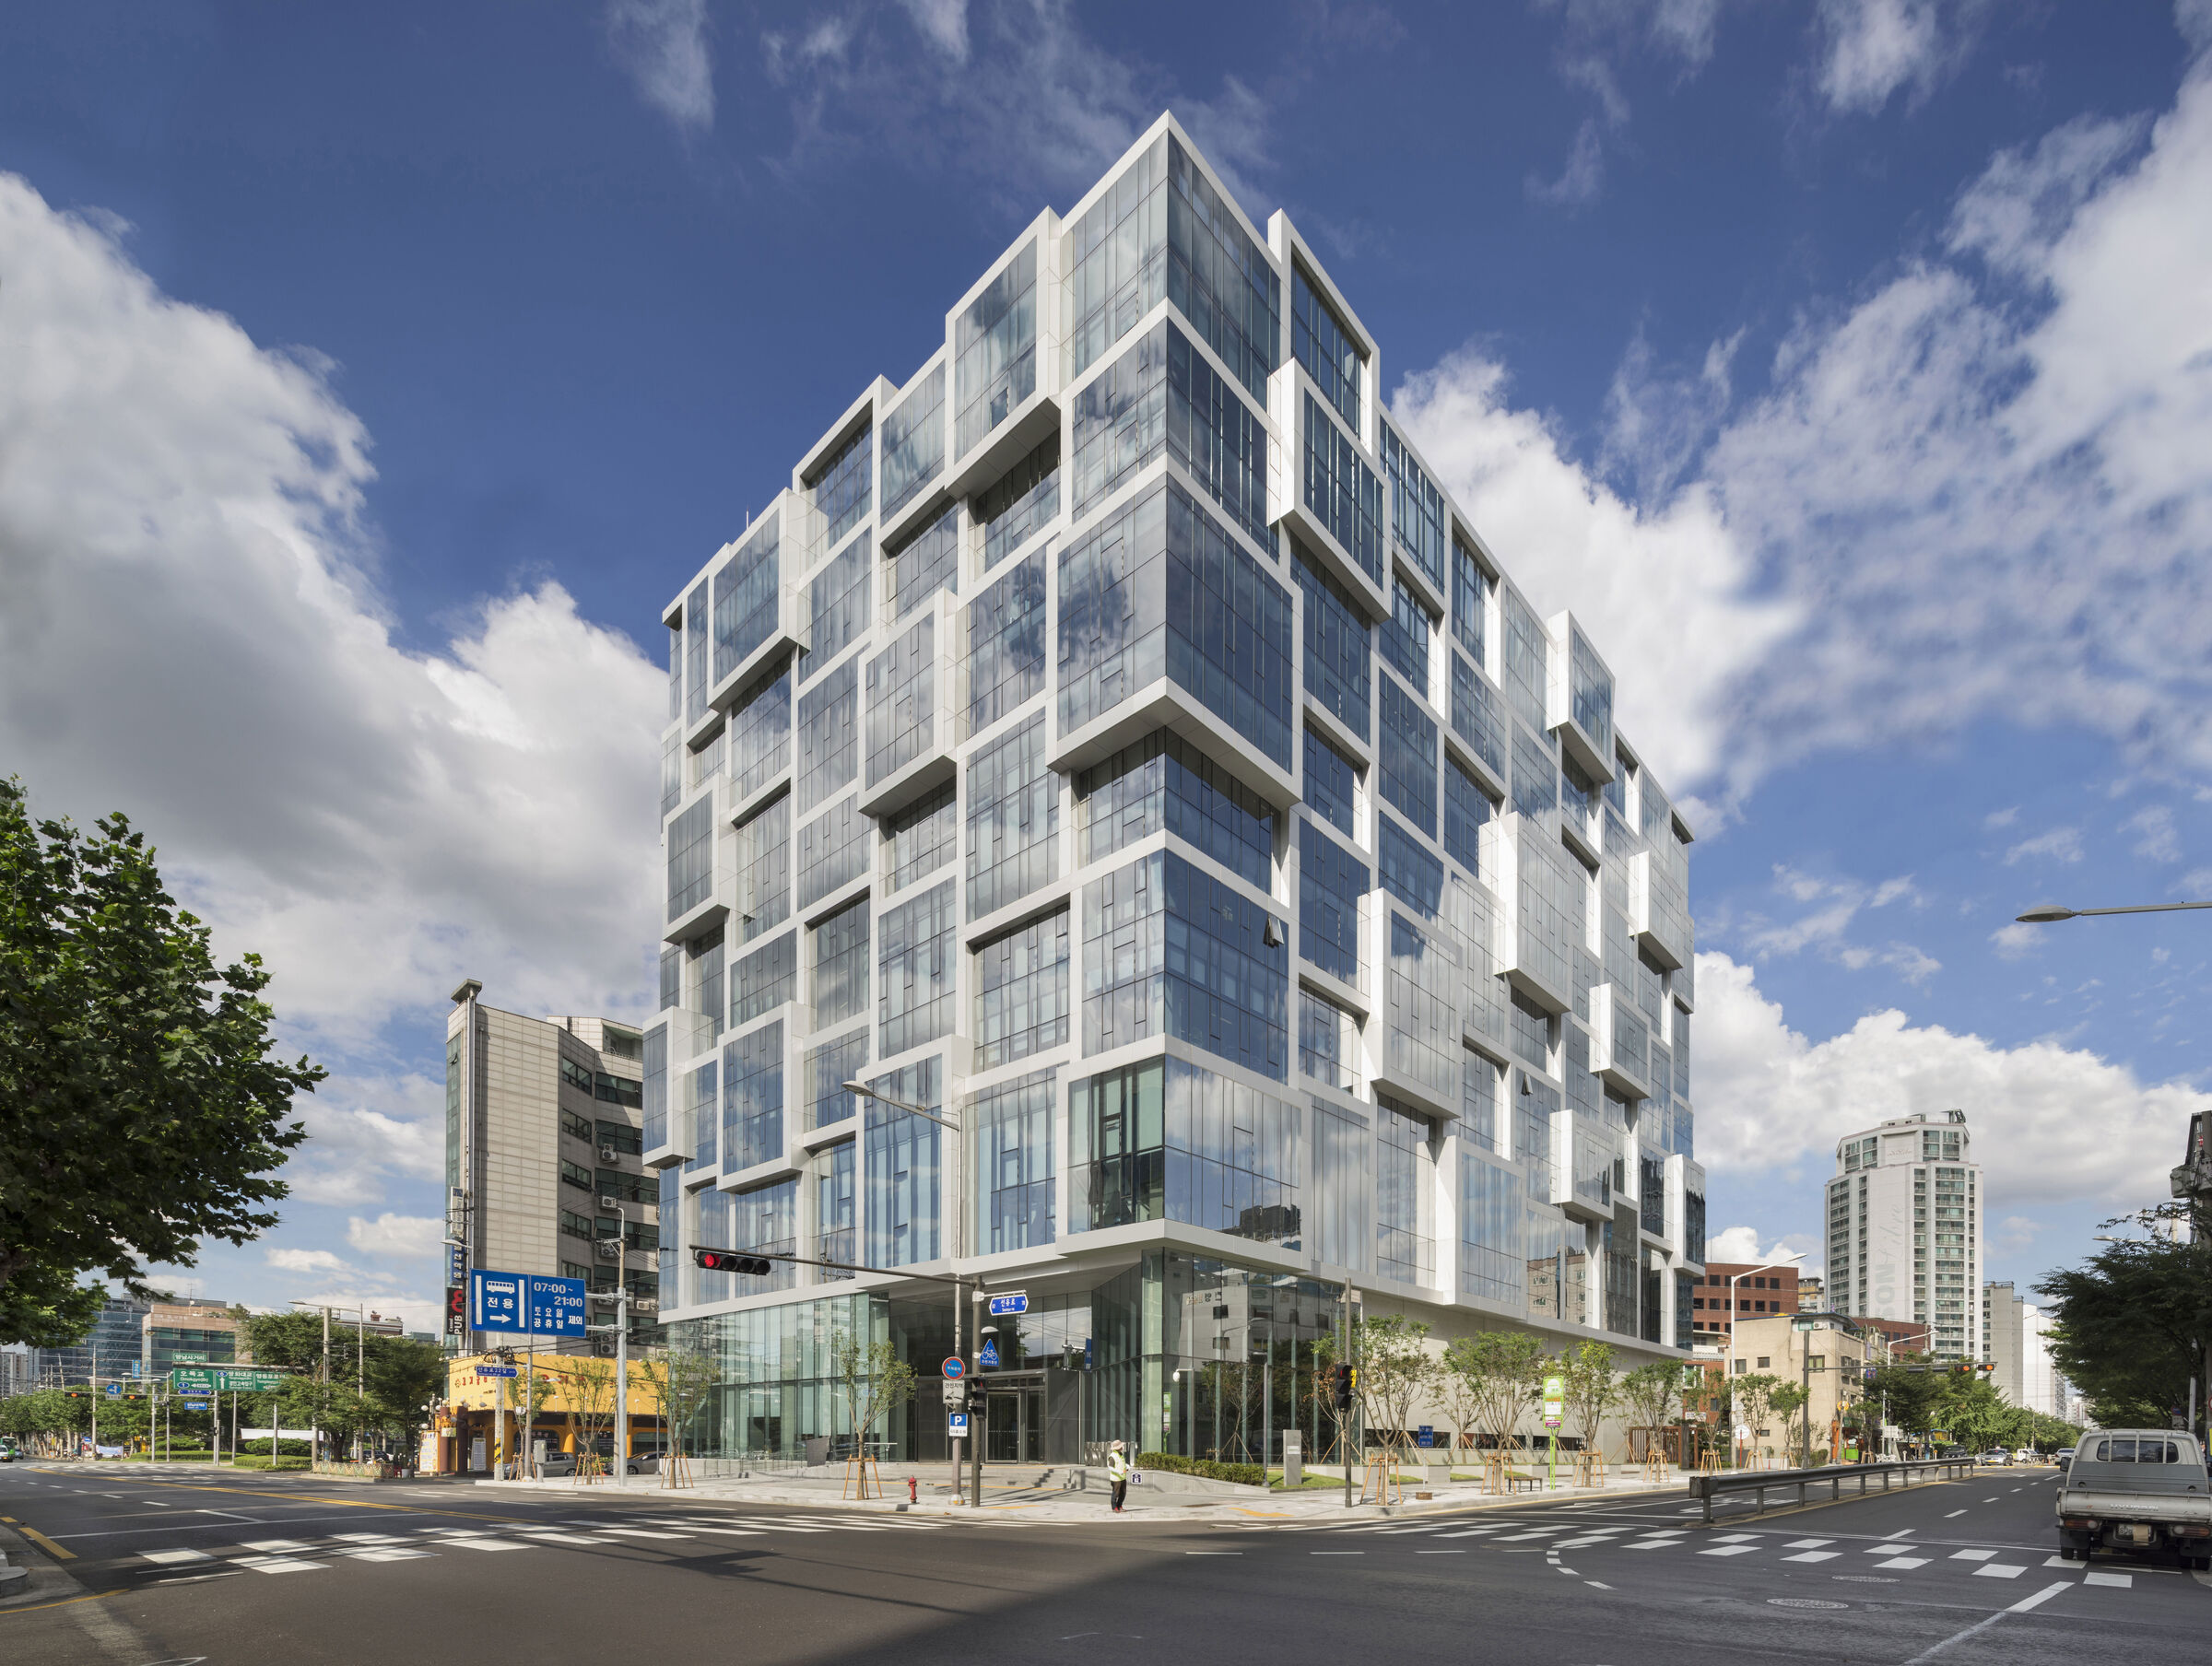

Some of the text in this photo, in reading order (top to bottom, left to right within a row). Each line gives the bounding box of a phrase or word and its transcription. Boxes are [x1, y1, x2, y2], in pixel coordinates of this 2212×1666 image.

[554, 1296, 582, 1308] 21:00
[453, 1315, 463, 1335] PUB
[568, 1315, 583, 1325] 제외
[954, 1415, 962, 1425] P
